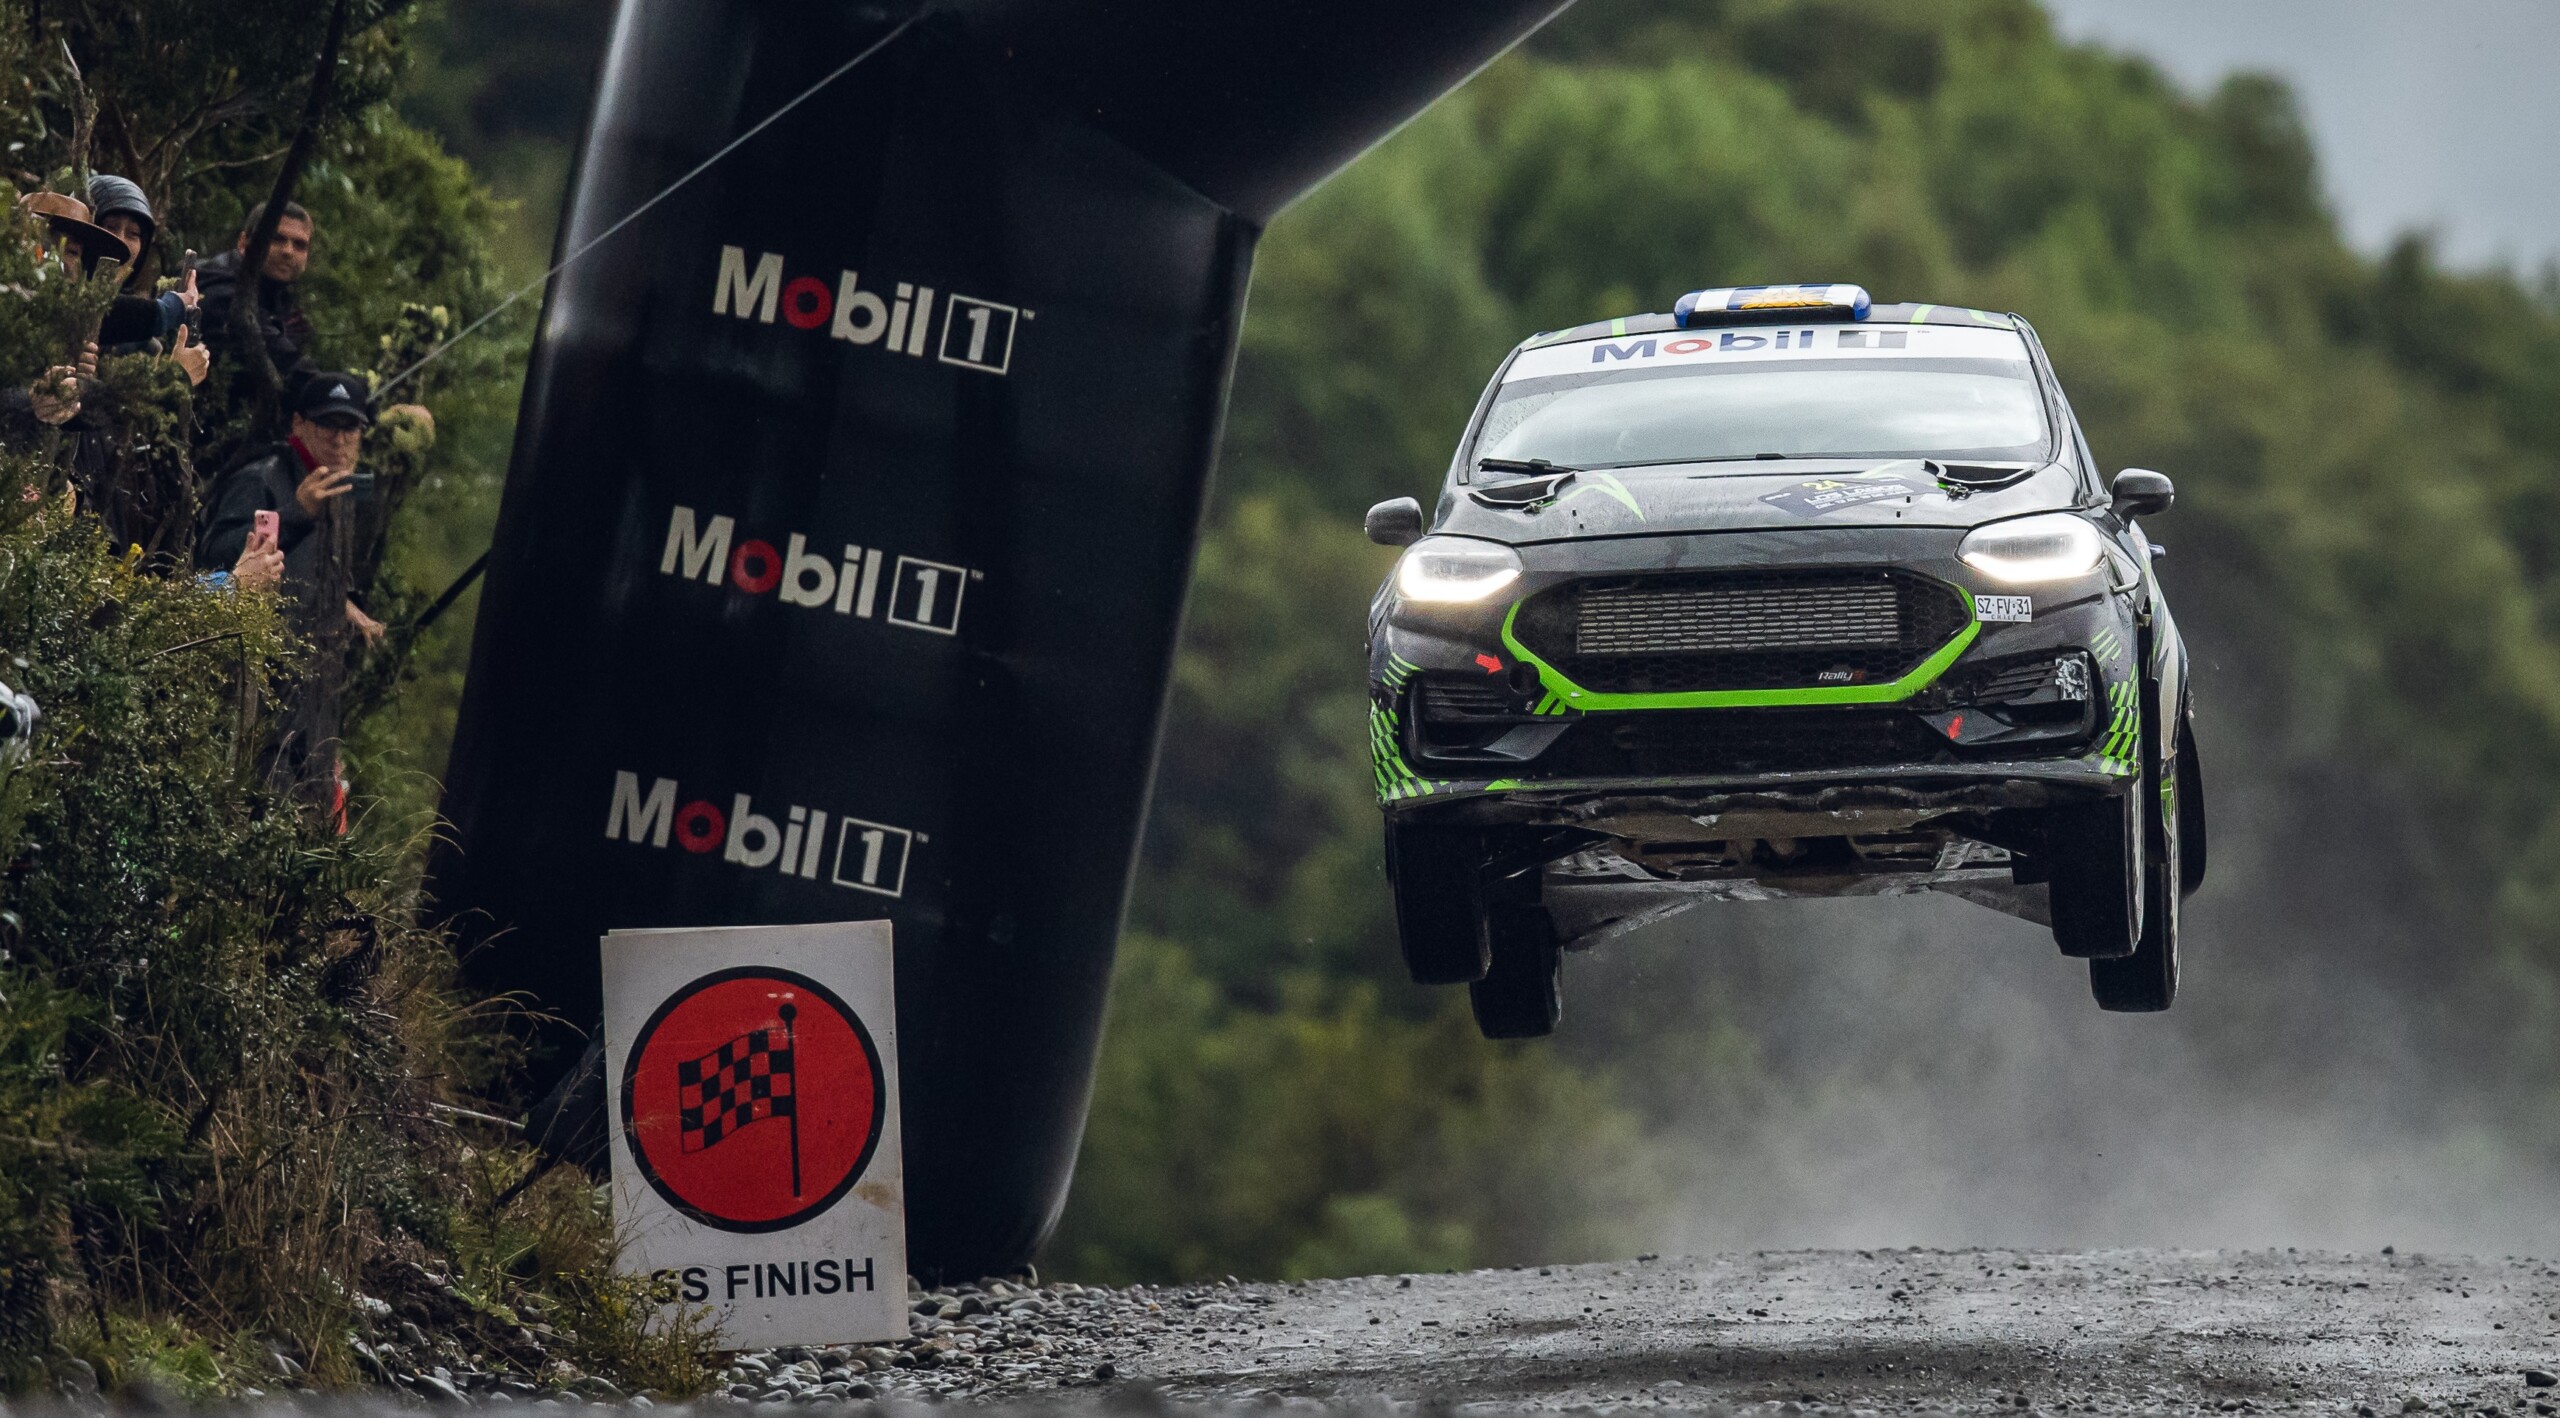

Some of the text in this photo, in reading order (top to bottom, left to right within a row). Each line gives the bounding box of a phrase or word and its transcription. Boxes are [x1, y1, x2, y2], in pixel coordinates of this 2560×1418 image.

[713, 245, 934, 357] Mobil
[1592, 330, 1815, 363] Mobil
[660, 505, 883, 619] Mobil
[605, 769, 828, 879] Mobil
[726, 1257, 875, 1300] FINISH
